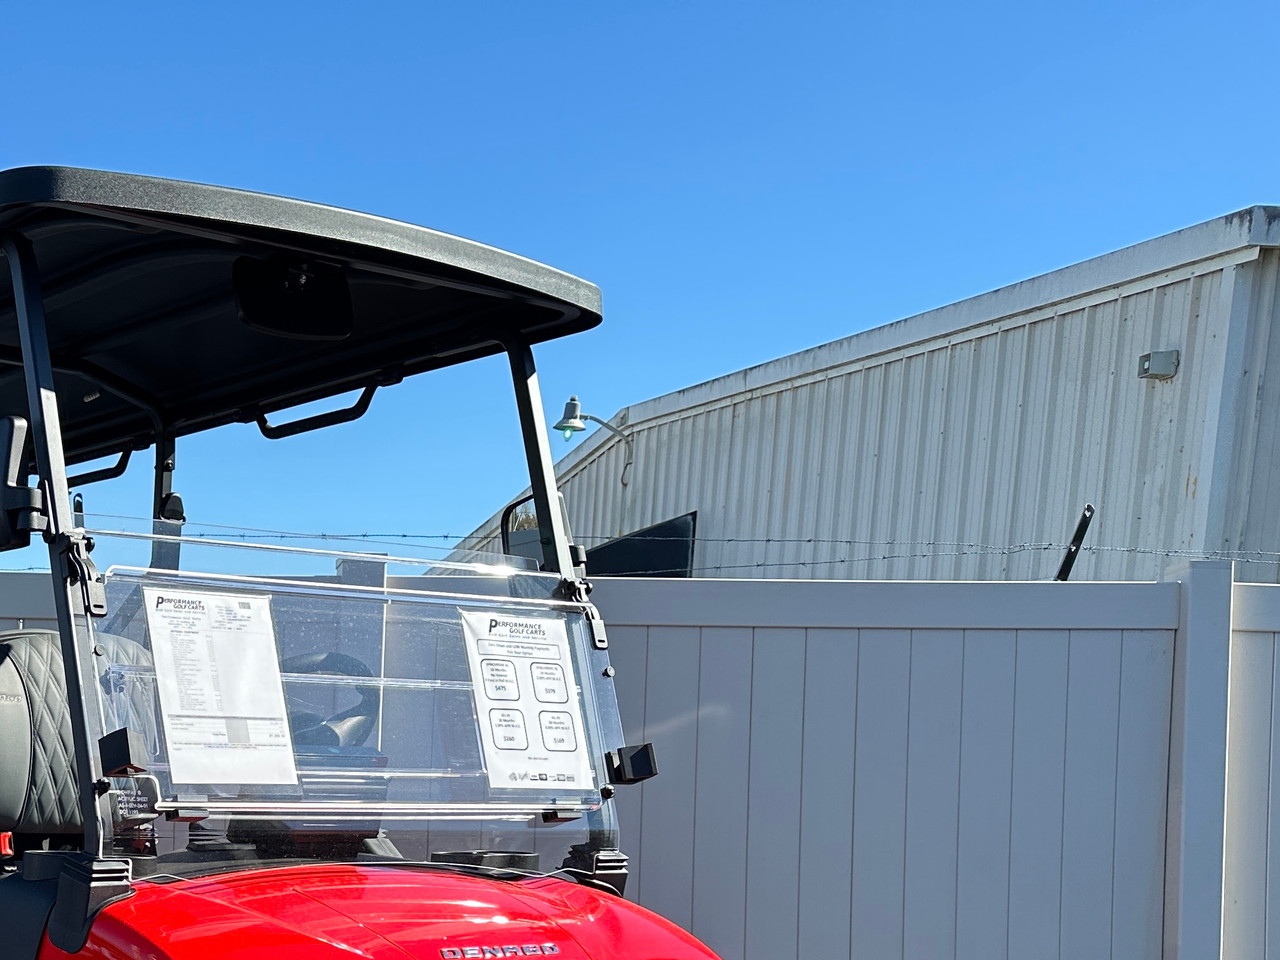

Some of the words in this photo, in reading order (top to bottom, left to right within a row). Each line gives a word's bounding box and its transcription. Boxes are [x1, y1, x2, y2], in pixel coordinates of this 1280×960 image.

[156, 596, 201, 608] PERFORMANCE
[489, 619, 541, 632] PERFORMANCE
[440, 943, 560, 960] DENAGO
